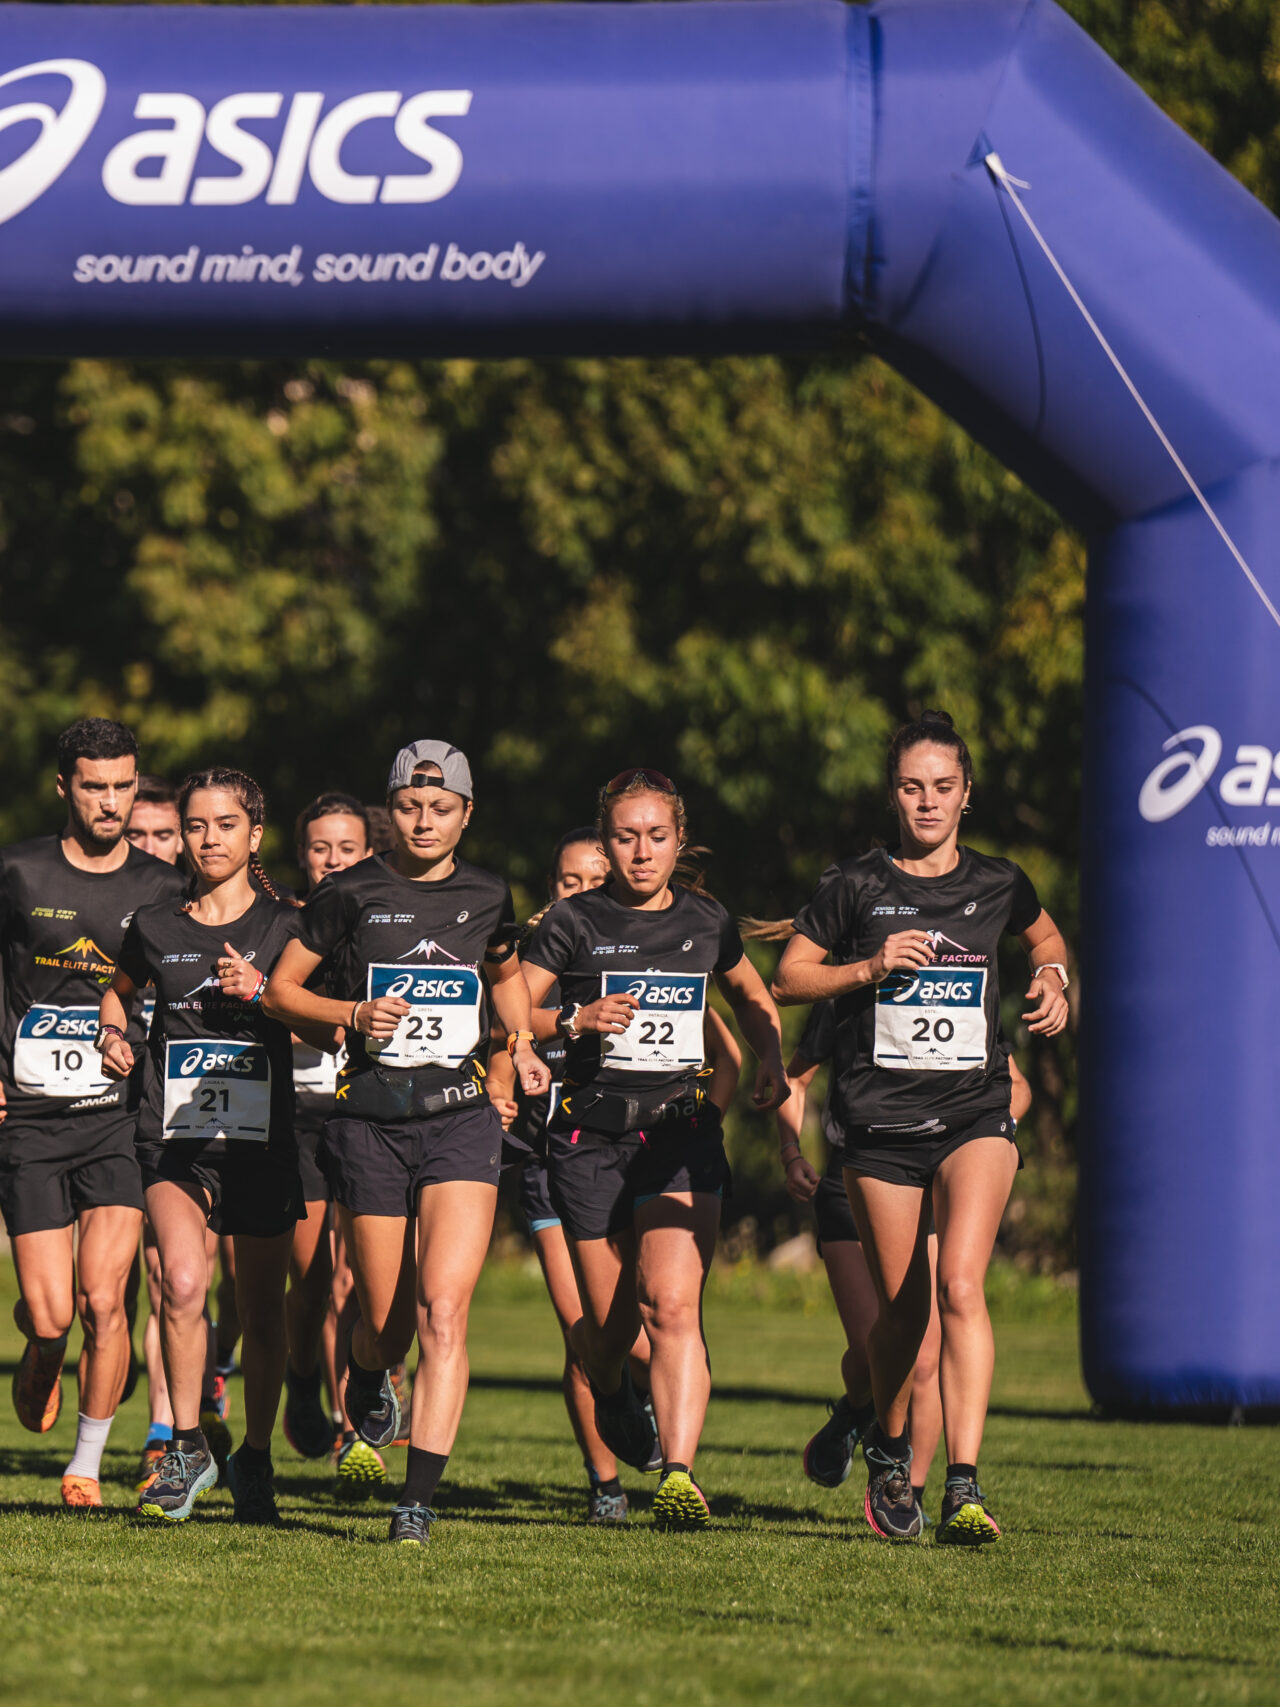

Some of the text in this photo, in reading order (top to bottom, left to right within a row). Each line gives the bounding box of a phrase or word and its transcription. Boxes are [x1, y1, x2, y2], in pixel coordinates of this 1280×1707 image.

[73, 241, 546, 288] sound mind, sound body
[1205, 821, 1271, 847] sound
[35, 956, 116, 974] TRAIL ELITE FACT
[940, 954, 987, 963] FACTORY
[168, 1001, 191, 1010] TRAIL
[406, 1016, 443, 1040] 23
[639, 1021, 674, 1045] 22
[911, 1017, 955, 1042] 20
[51, 1050, 83, 1071] 10
[200, 1088, 229, 1112] 21
